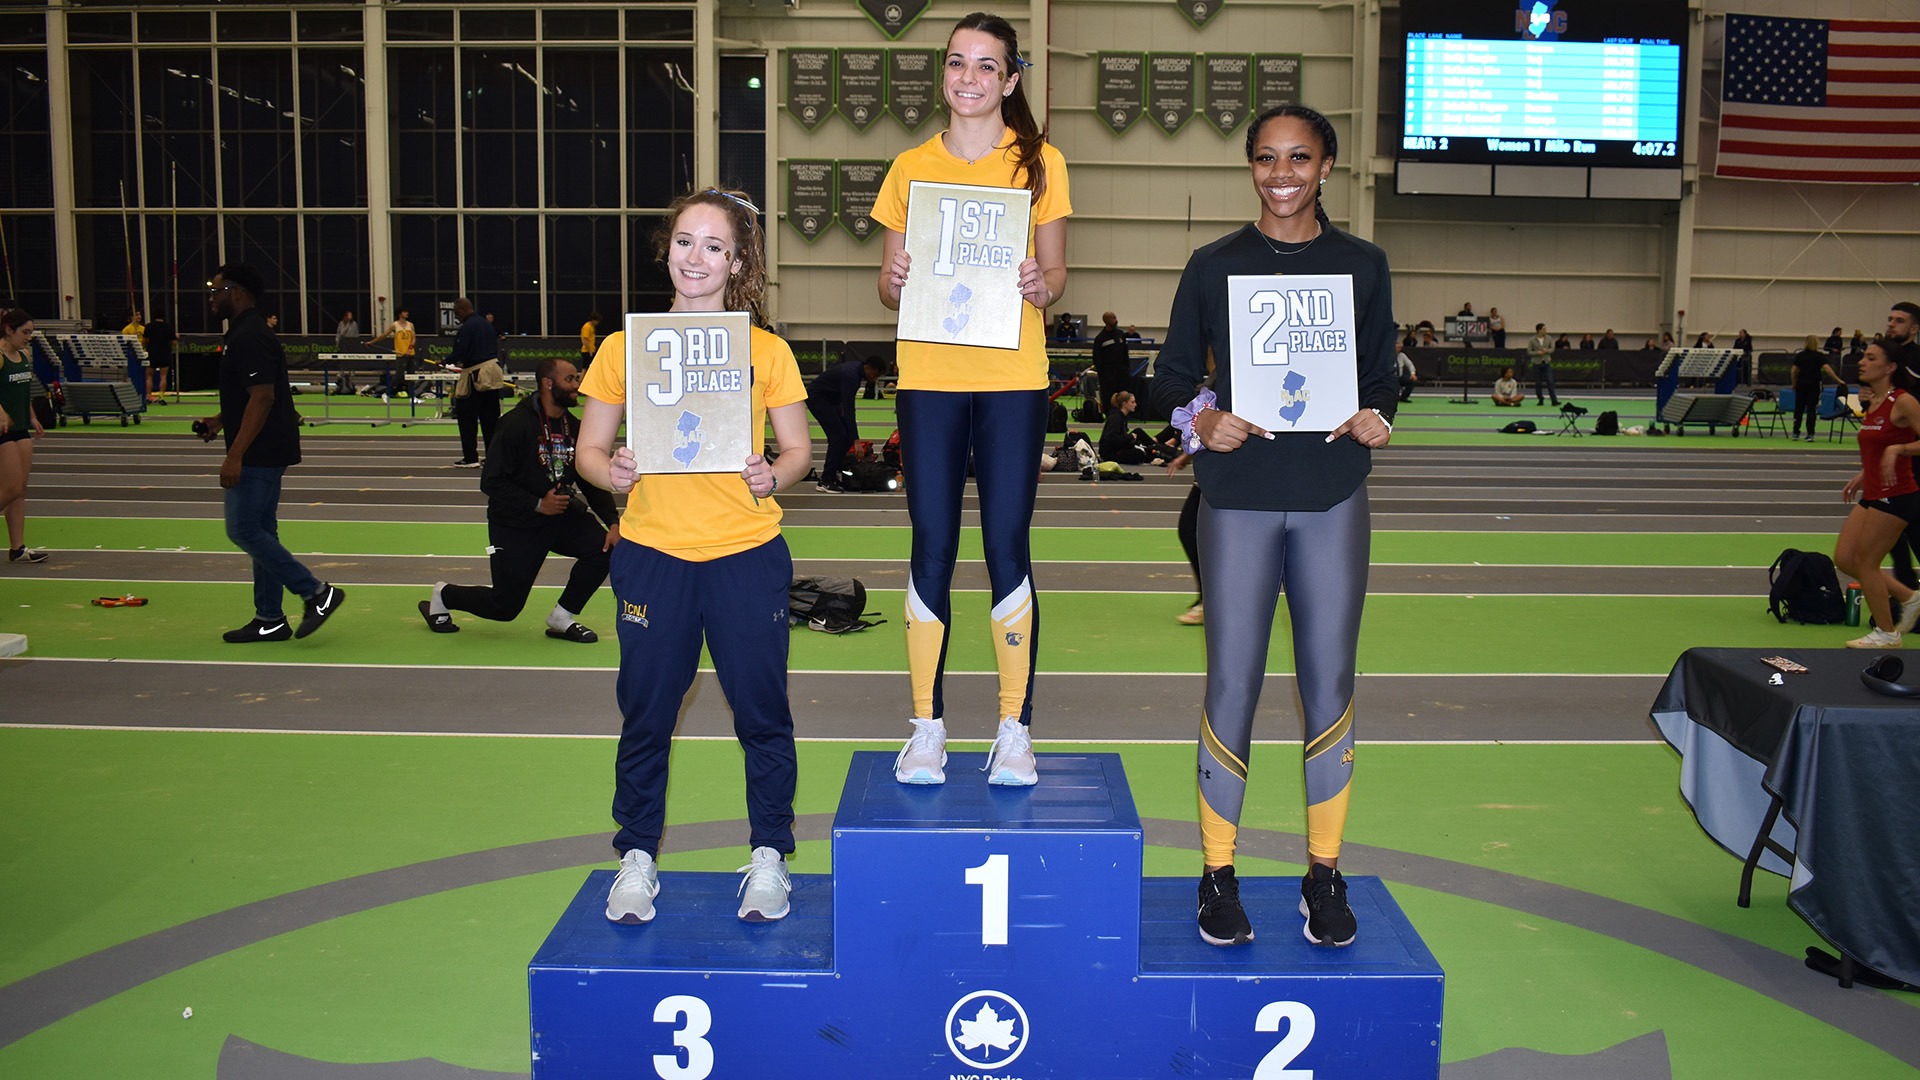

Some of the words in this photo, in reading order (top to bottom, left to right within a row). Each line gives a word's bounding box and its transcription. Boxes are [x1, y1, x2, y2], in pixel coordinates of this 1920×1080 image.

[1407, 112, 1414, 121] 7
[1403, 137, 1436, 149] HEAT:
[1439, 137, 1448, 150] 2
[1486, 139, 1531, 152] Women
[1534, 140, 1540, 152] 1
[1545, 140, 1571, 153] Mile
[1573, 141, 1596, 153] Run
[1632, 143, 1676, 156] 4:07.2
[933, 198, 1006, 276] 1ST
[957, 243, 1012, 270] PLACE
[1249, 289, 1334, 366] 2ND
[190, 343, 217, 352] Breez
[428, 344, 453, 354] Ocea
[1289, 330, 1346, 352] PLACE
[646, 327, 730, 406] 3RD
[686, 370, 741, 392] PLACE
[623, 600, 647, 618] TCNJ
[965, 854, 1009, 945] 1
[652, 995, 714, 1080] 3
[1252, 1000, 1316, 1080] 2
